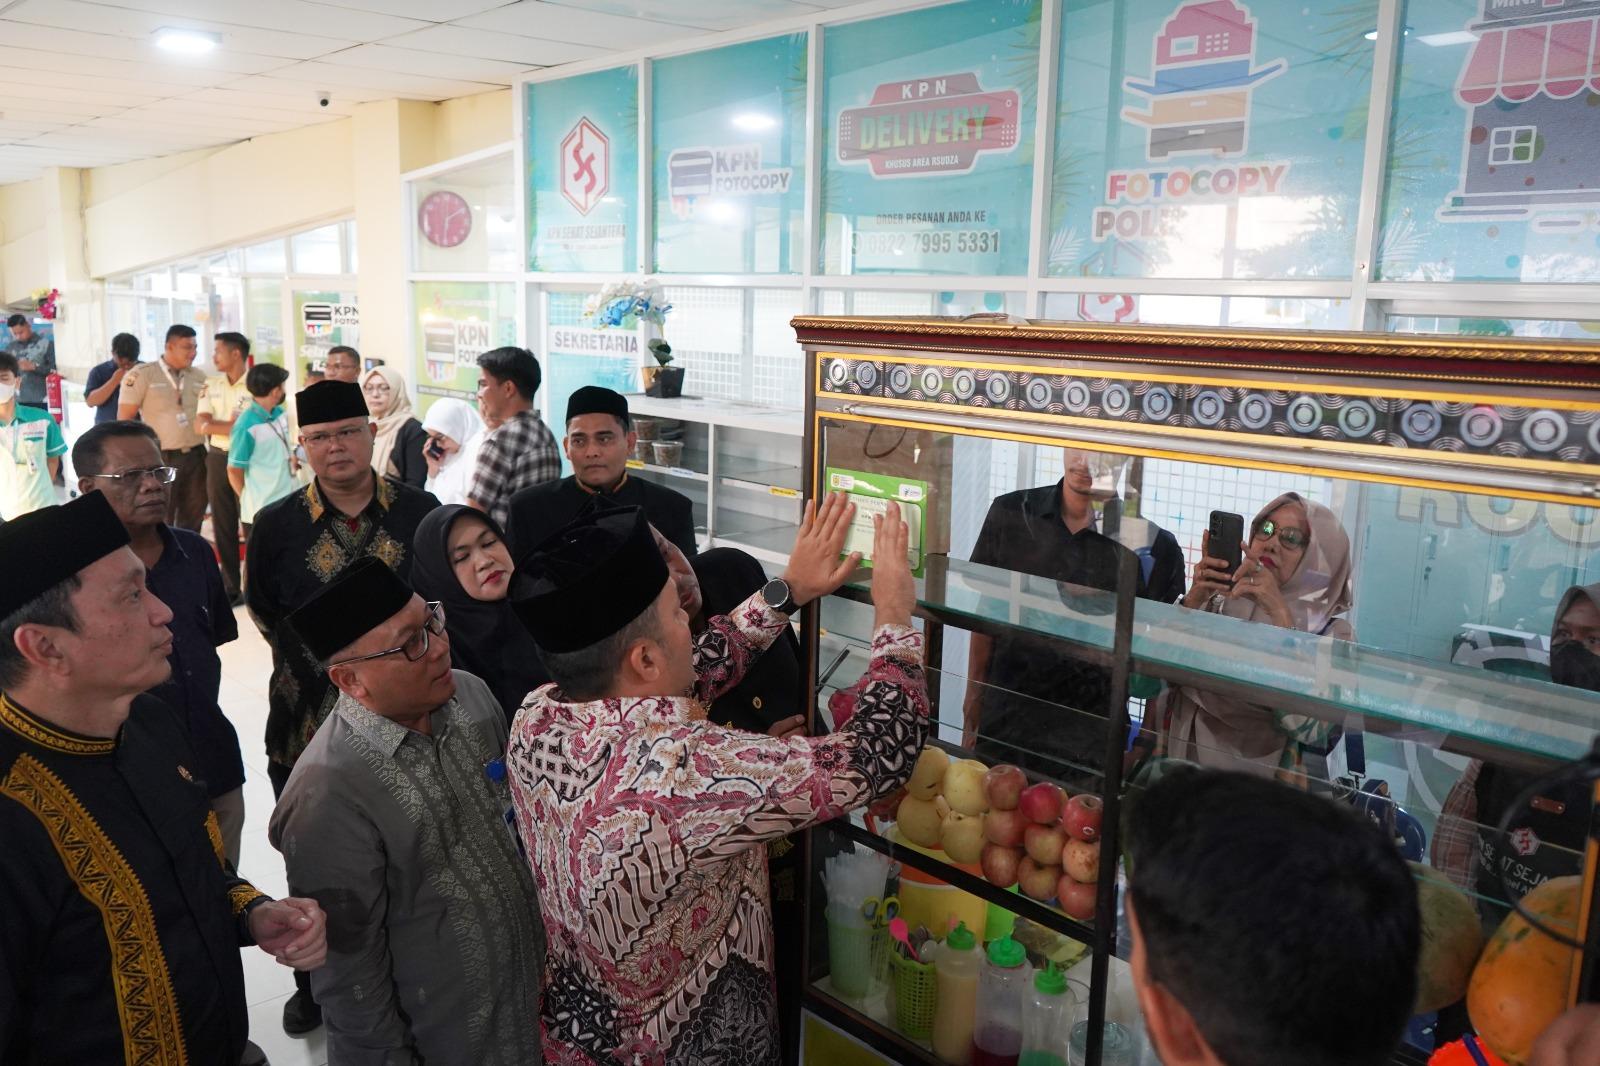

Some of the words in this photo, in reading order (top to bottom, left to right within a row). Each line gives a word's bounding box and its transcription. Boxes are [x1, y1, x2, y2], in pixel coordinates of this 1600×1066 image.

[902, 79, 947, 99] KPN
[859, 104, 990, 150] DELIVERY
[716, 149, 759, 173] KPN
[885, 158, 911, 169] KHUSUS
[912, 157, 930, 168] AREA
[931, 155, 959, 167] RSUDZA
[716, 172, 790, 191] FOTOCOPY
[1108, 166, 1285, 200] FOTOCOPY
[876, 213, 903, 225] ORDER
[905, 211, 945, 224] PESANAN
[947, 210, 972, 223] ANDA
[974, 210, 986, 222] KE
[912, 232, 952, 254] 7995
[957, 231, 999, 254] 5331
[334, 306, 359, 316] KPN
[458, 324, 489, 346] KPN
[554, 331, 638, 353] SEKRETARIA
